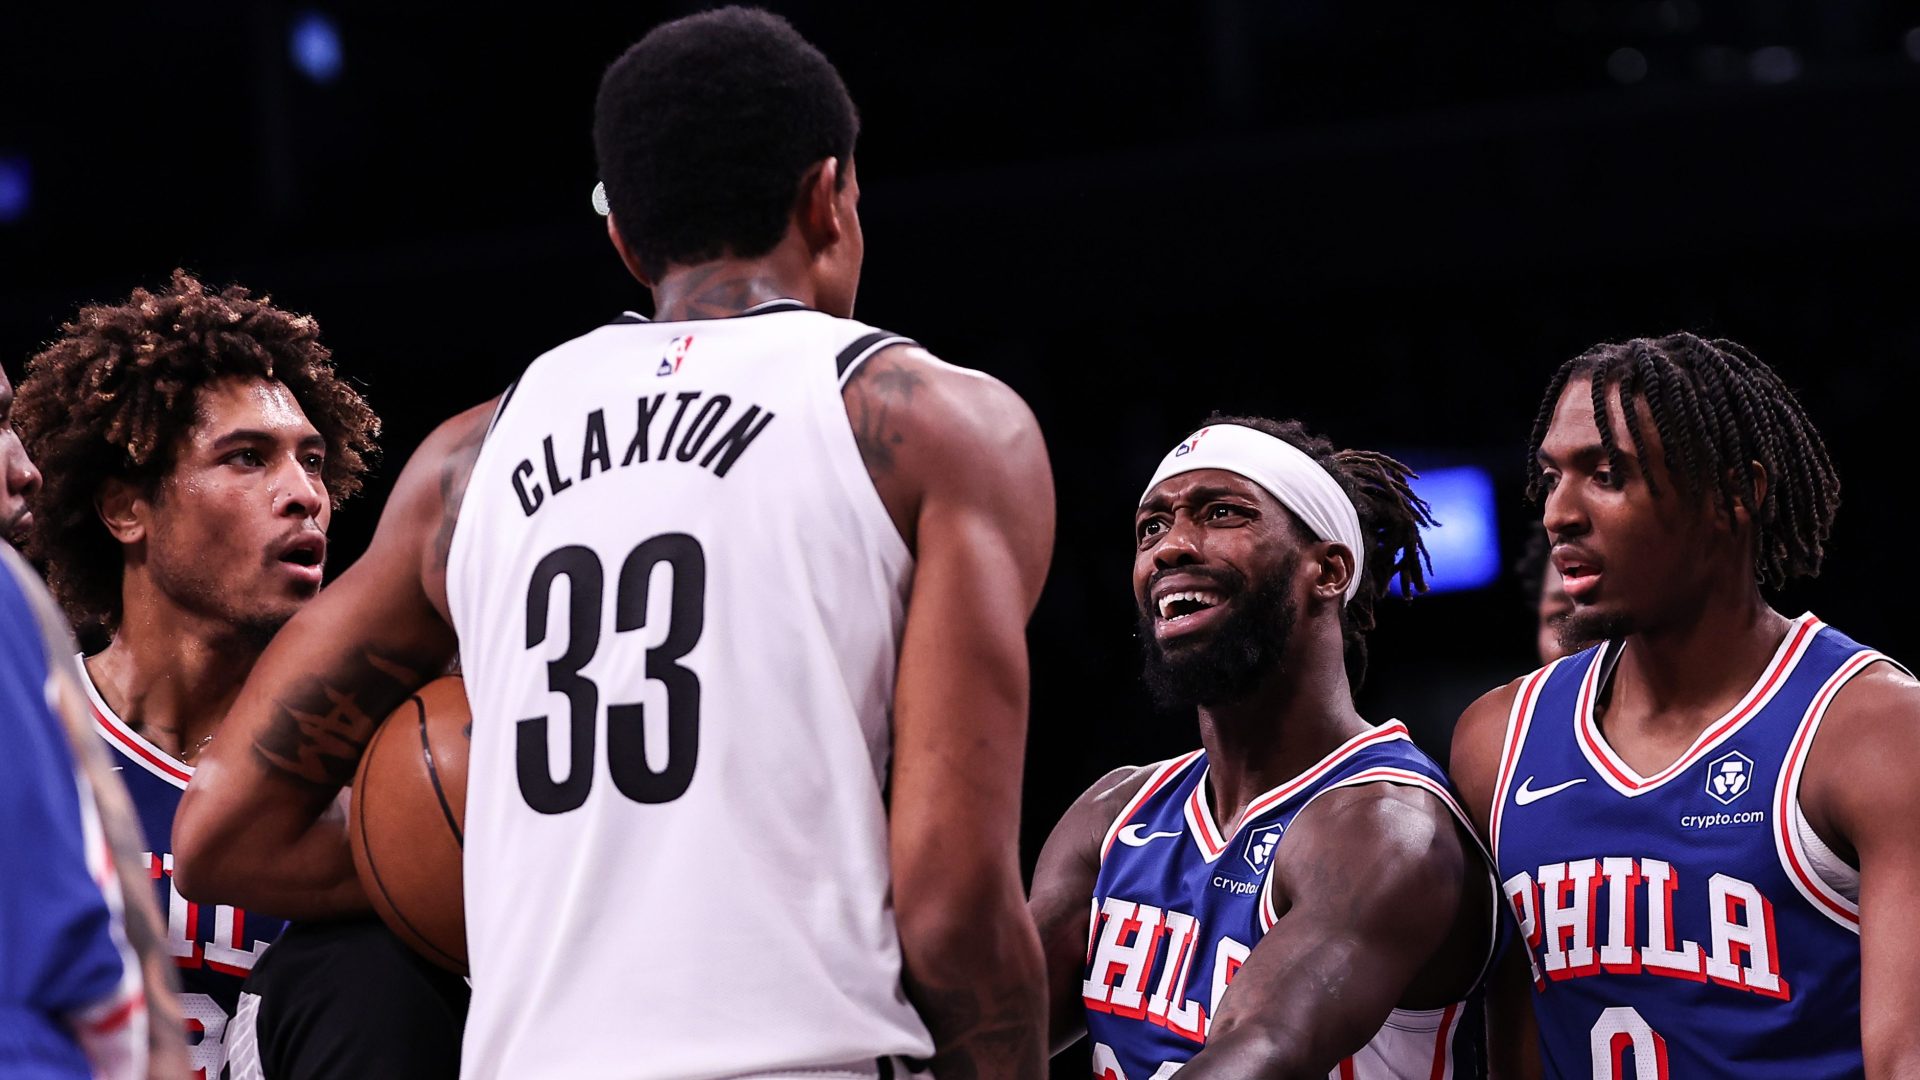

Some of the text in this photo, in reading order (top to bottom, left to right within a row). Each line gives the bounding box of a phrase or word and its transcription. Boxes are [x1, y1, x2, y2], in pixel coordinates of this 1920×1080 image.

[511, 390, 775, 517] CLAXTON
[516, 532, 705, 815] 33
[1681, 811, 1764, 829] crypto.com
[1082, 896, 1252, 1044] HIL
[1502, 856, 1790, 1001] PHILA
